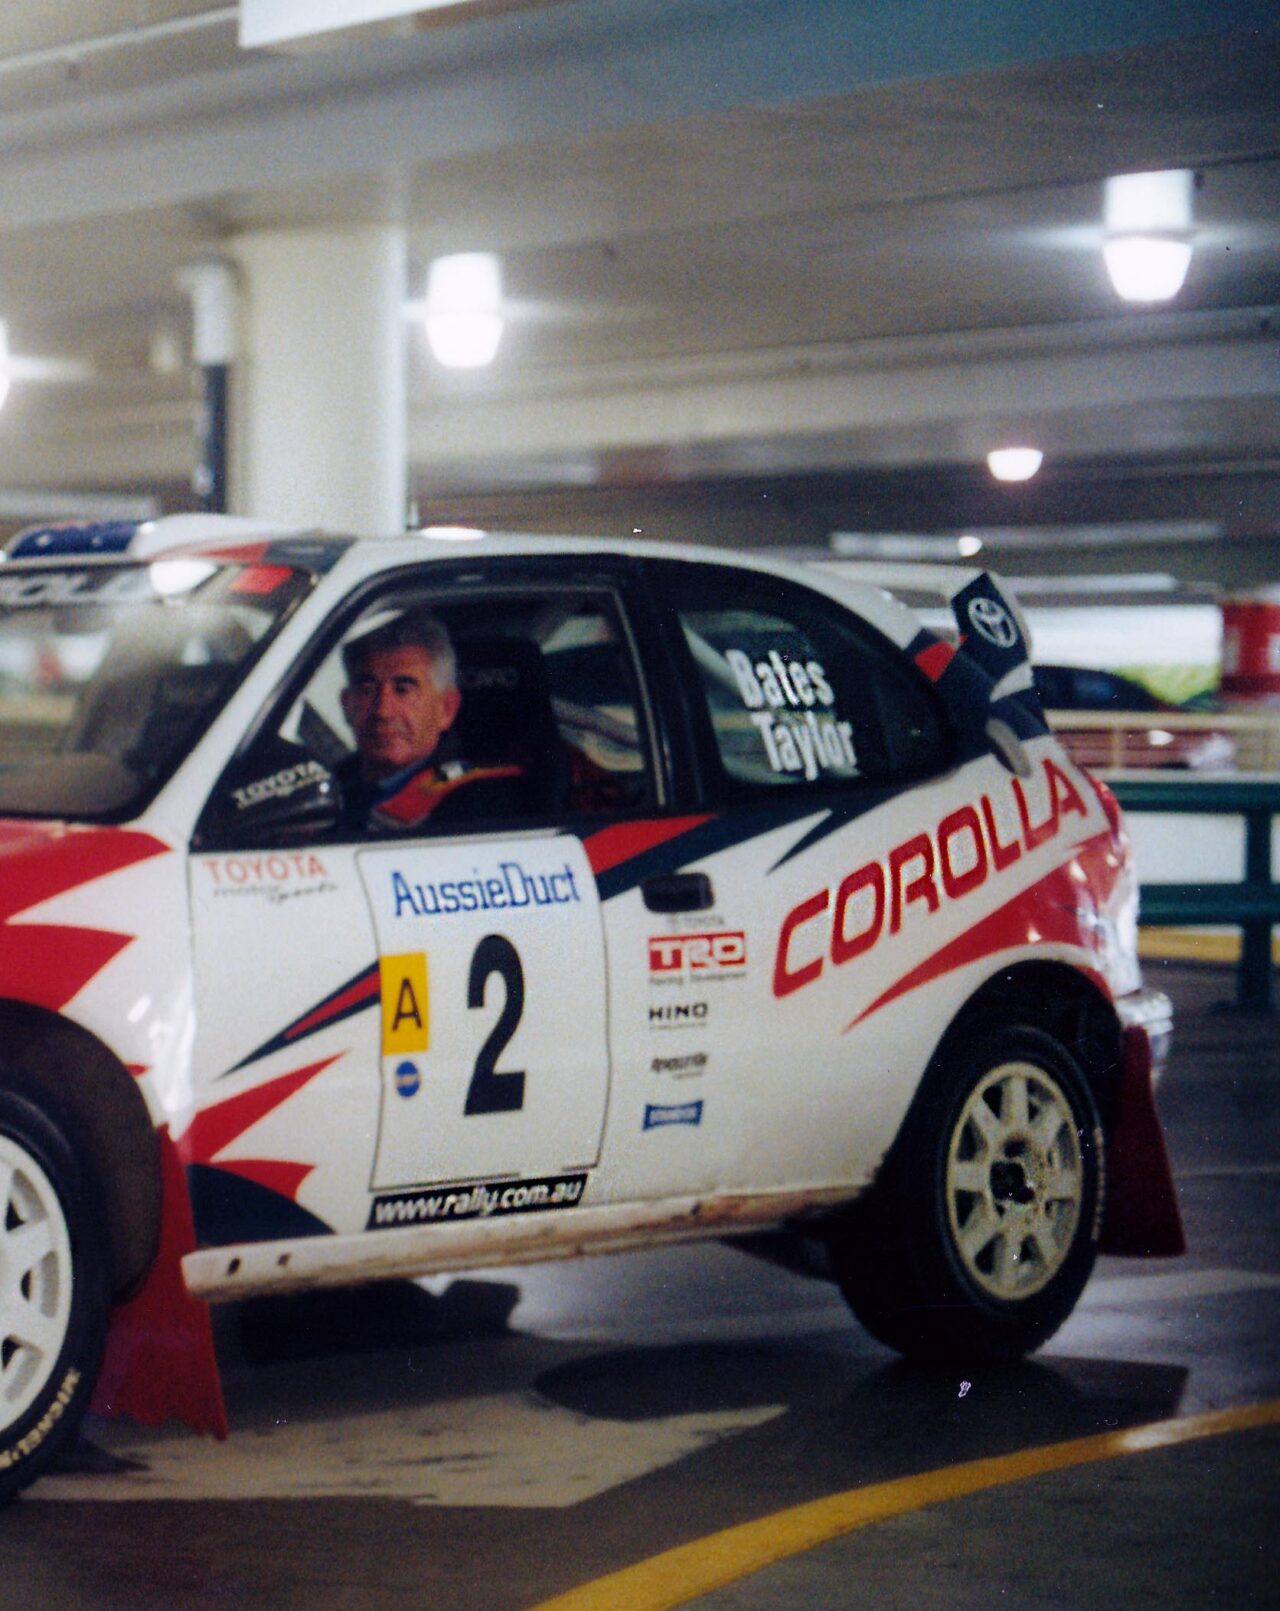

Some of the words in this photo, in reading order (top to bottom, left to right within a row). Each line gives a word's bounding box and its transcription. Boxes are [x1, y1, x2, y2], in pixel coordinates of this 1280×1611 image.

[725, 649, 835, 708] Bates
[751, 710, 857, 781] Taylor
[232, 760, 332, 802] TOYOTA
[203, 851, 327, 884] TOYOTA
[391, 861, 581, 918] AussieDuct
[773, 758, 1088, 998] COROLLA
[649, 935, 745, 971] TRD
[392, 977, 423, 1032] A
[463, 934, 526, 1116] 2
[649, 1001, 708, 1021] HINO
[375, 1179, 582, 1224] www.rally.com.au
